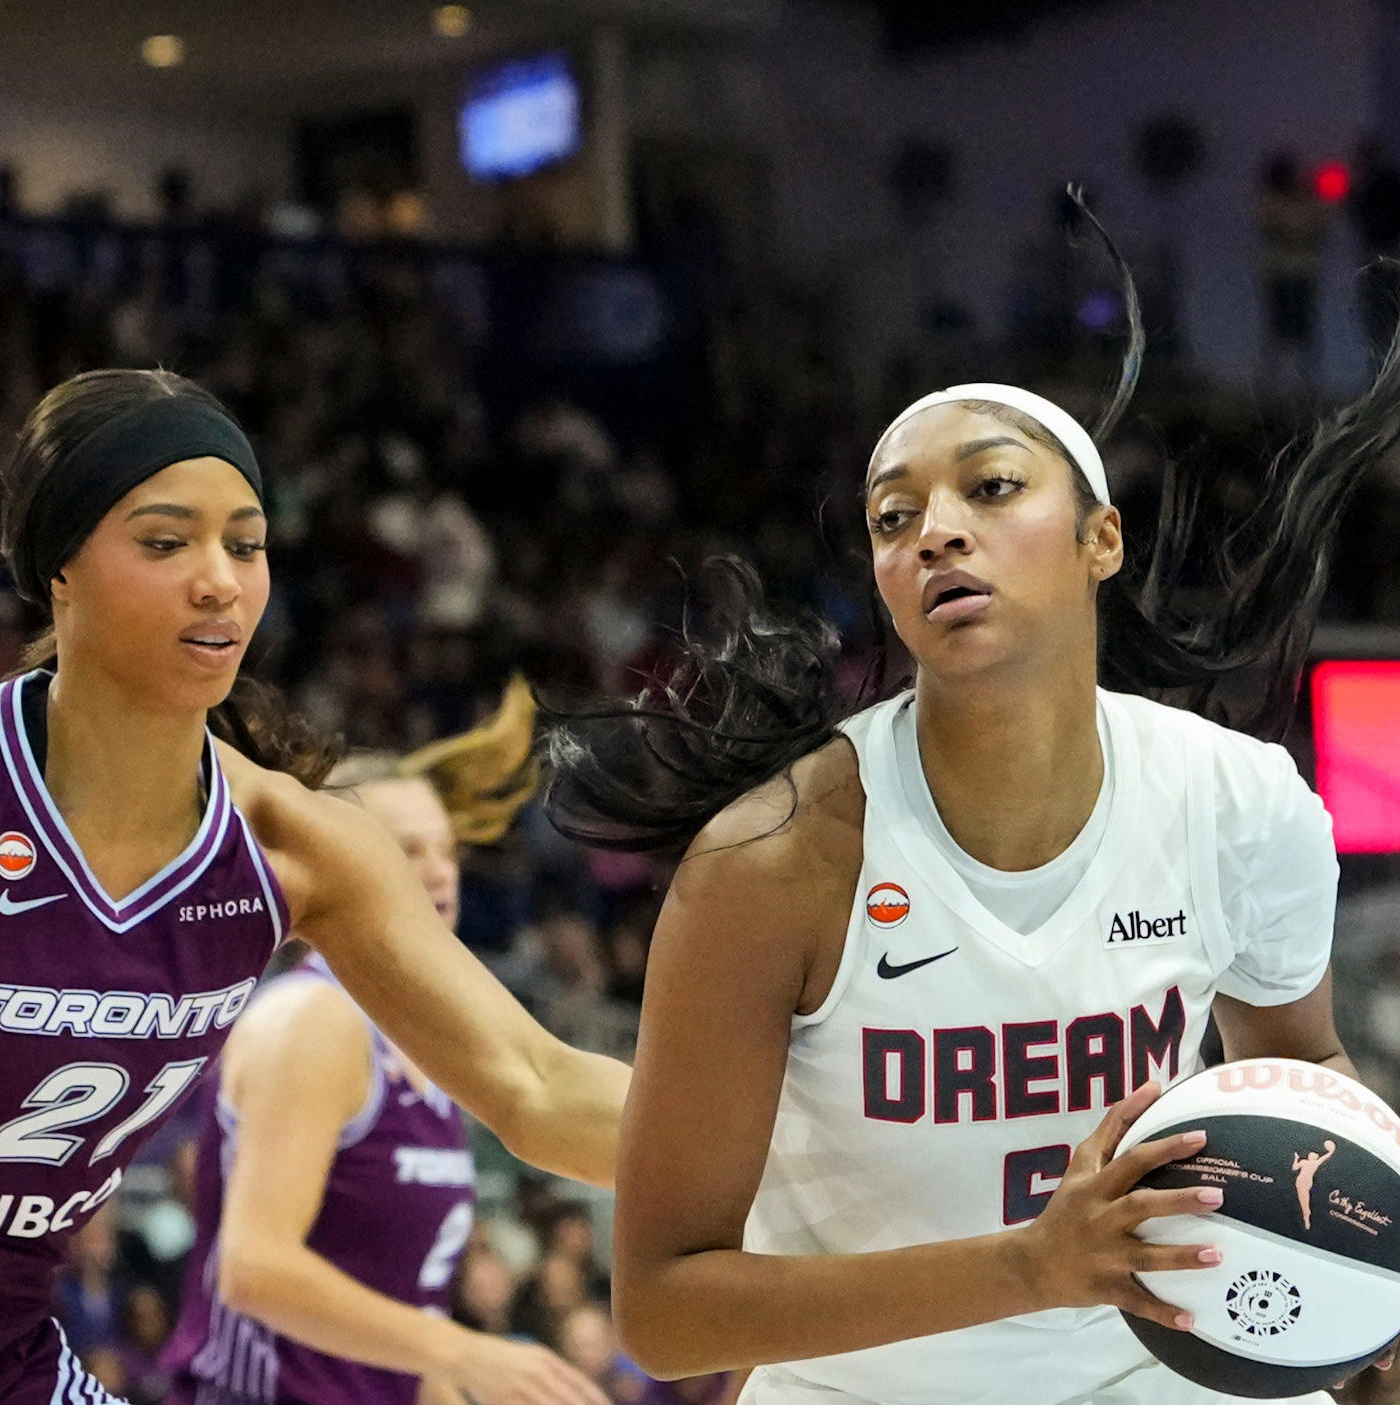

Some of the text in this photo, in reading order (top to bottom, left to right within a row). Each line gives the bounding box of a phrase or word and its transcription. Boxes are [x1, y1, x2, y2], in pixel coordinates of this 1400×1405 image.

[178, 896, 264, 922] SEPHORA
[1107, 909, 1188, 942] Albert
[861, 984, 1187, 1124] DREAM
[1196, 1156, 1241, 1169] OFFICIAL
[1200, 1173, 1228, 1183] BALL
[1249, 1173, 1274, 1184] CUP
